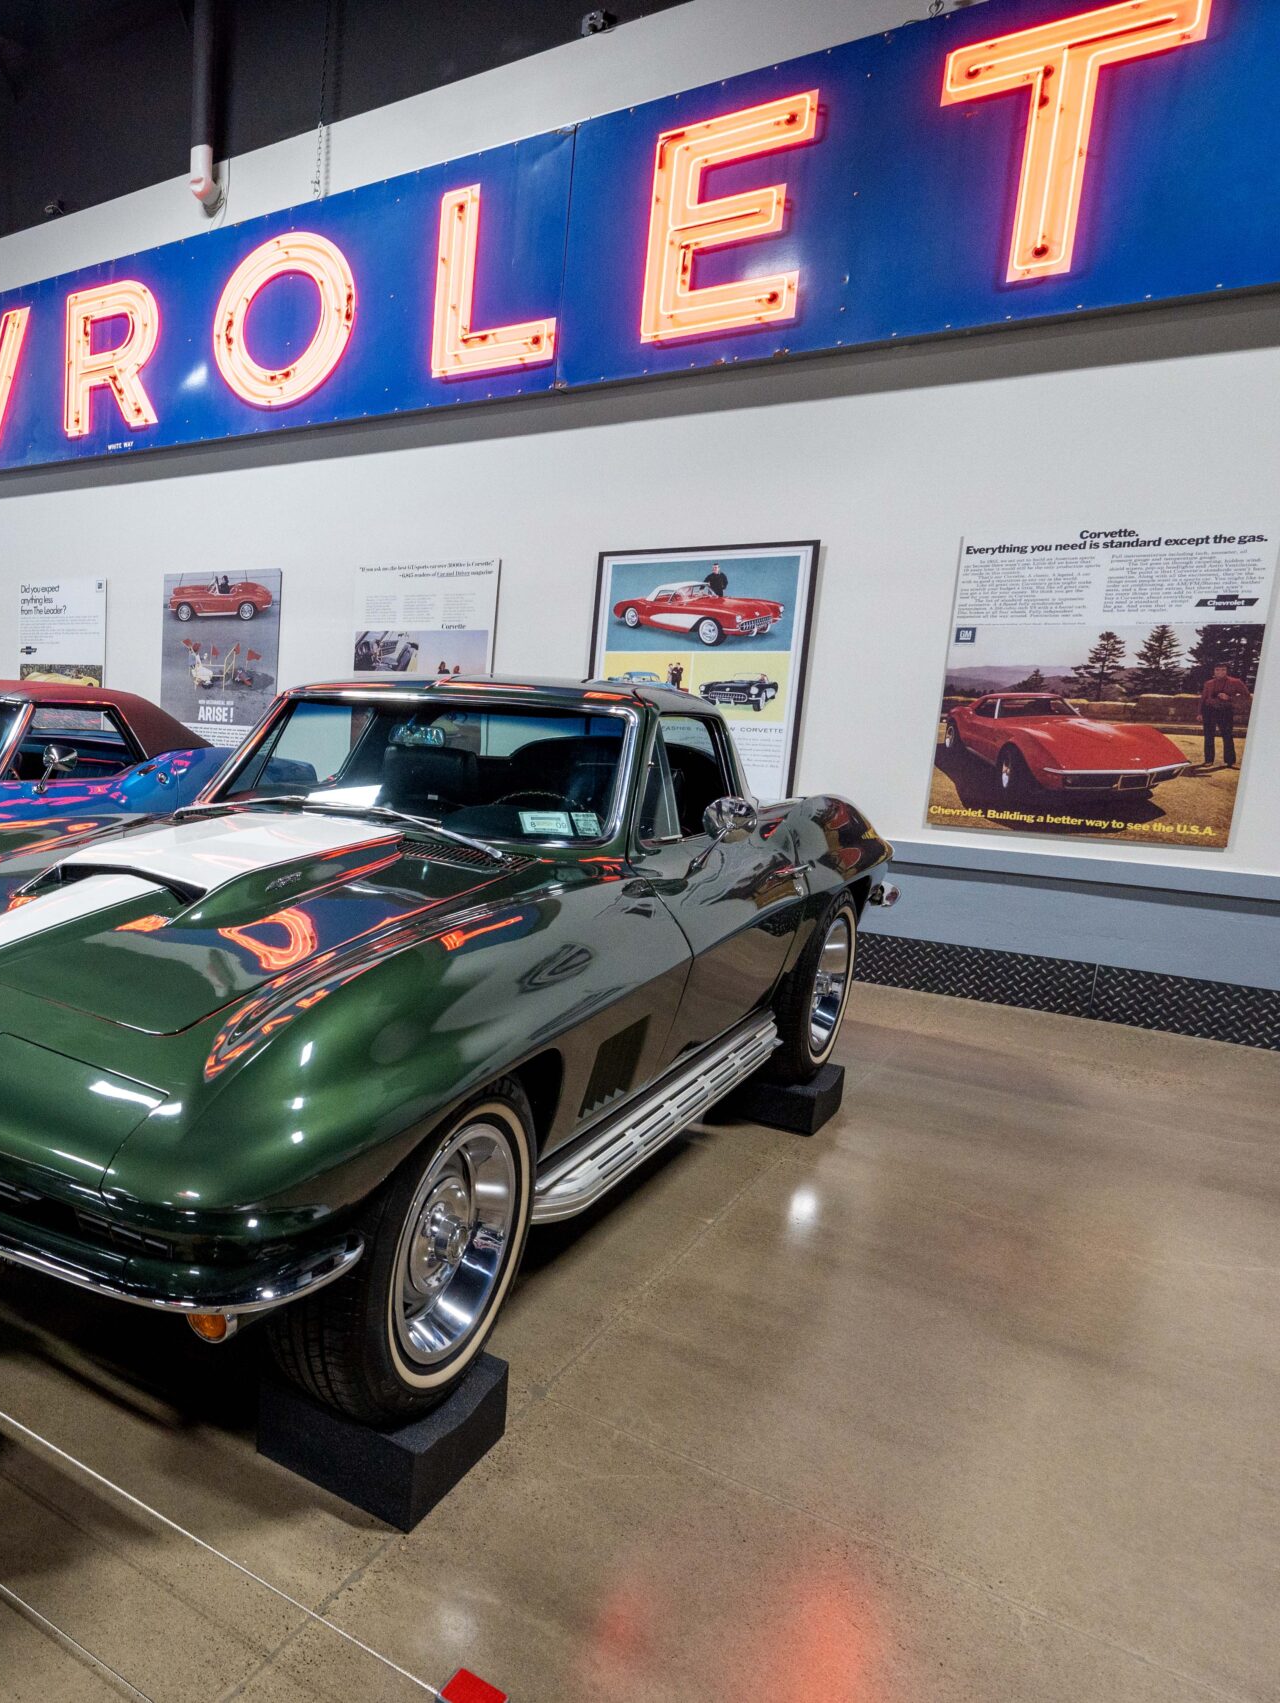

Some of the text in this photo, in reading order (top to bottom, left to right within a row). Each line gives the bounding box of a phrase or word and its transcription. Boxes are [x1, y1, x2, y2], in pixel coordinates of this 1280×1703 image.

[1079, 529, 1140, 540] Corvette.
[966, 534, 1269, 555] Everything you need is standard except the gas.
[20, 584, 60, 595] Did you expect
[20, 595, 54, 606] anything less
[20, 605, 33, 615] from
[33, 606, 43, 615] The
[960, 630, 972, 638] GM
[198, 706, 234, 723] ARISE!
[929, 805, 1217, 836] Chevrolet. Building a better way to see the U.S.A.
